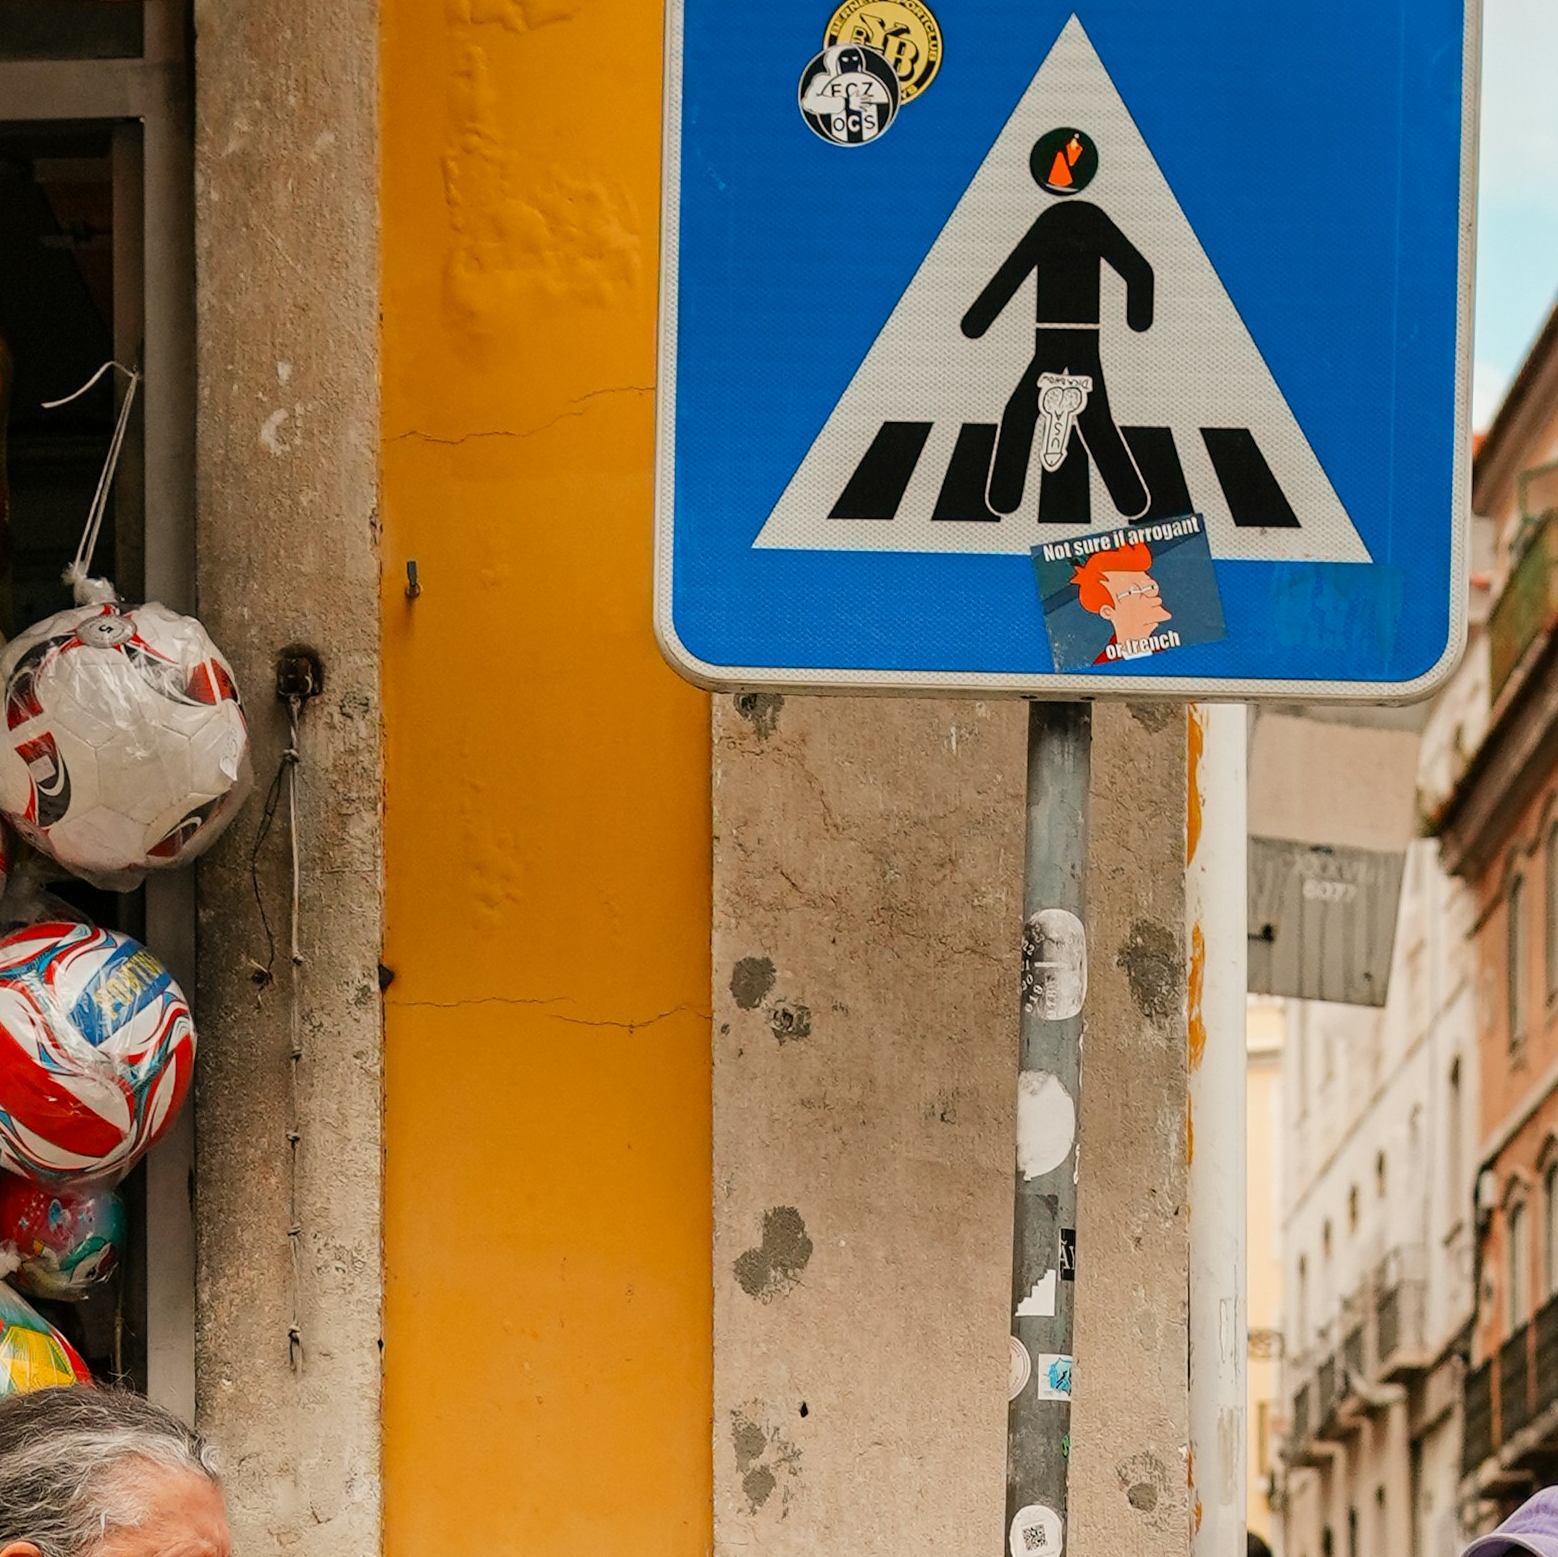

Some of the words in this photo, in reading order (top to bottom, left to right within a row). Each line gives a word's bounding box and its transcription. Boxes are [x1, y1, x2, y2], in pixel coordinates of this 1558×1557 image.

[832, 114, 876, 132] OCS
[1043, 544, 1072, 562] Not
[1075, 536, 1111, 556] sure
[1113, 530, 1126, 549] if
[1128, 516, 1200, 545] arrogant
[1106, 646, 1123, 660] or
[1124, 630, 1181, 656] french
